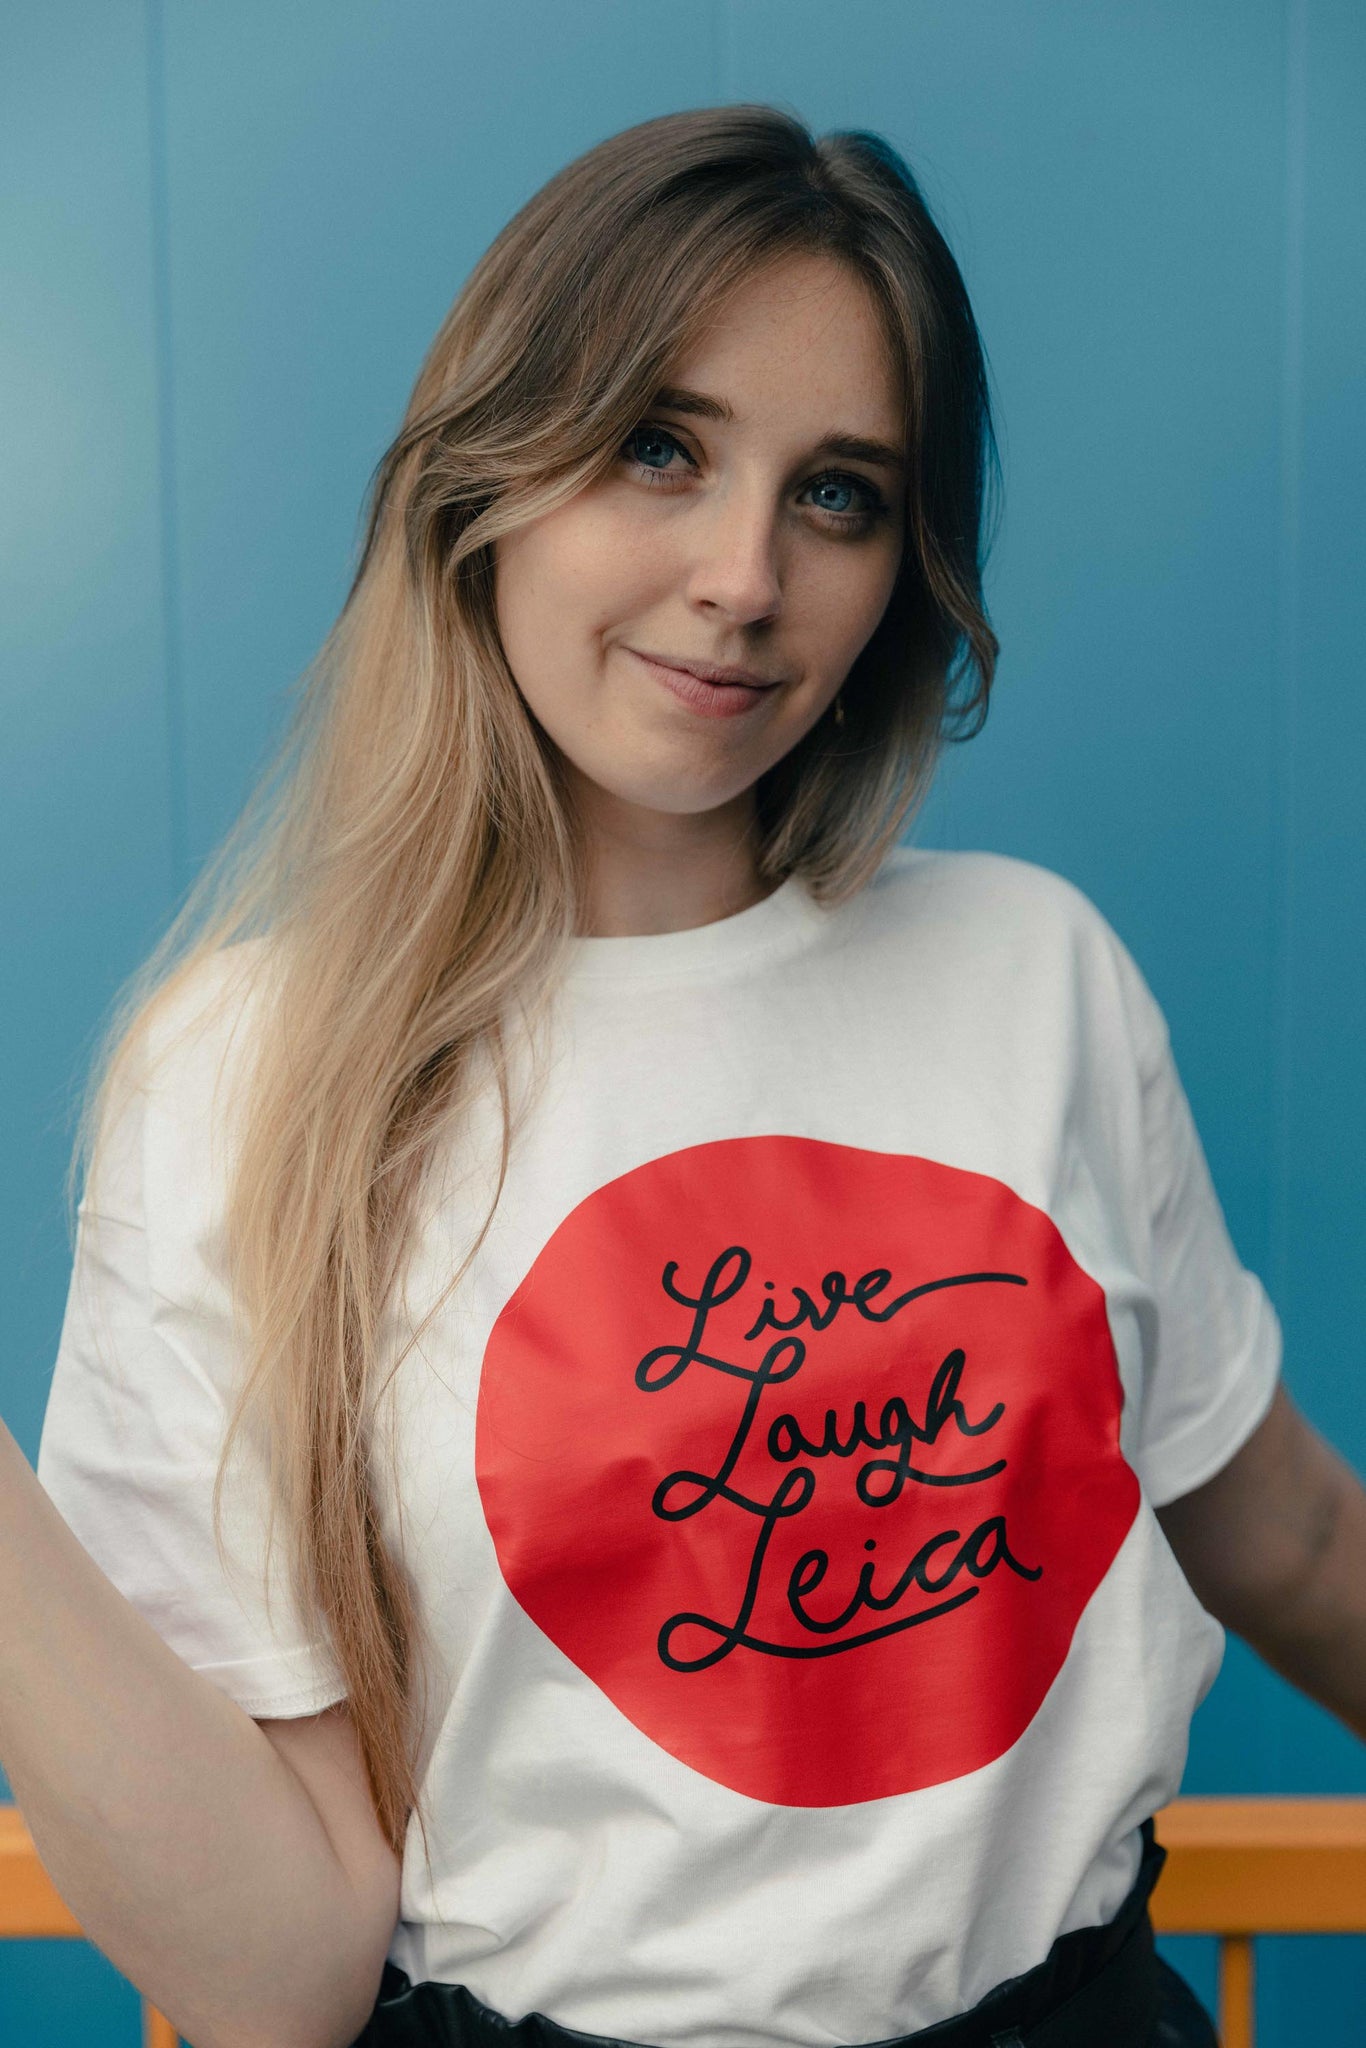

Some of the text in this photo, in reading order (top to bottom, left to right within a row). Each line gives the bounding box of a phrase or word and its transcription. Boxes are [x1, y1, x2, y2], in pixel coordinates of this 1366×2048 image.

[635, 1246, 1028, 1392] Live
[652, 1337, 1006, 1522] Laugh
[657, 1467, 1043, 1673] Leica
